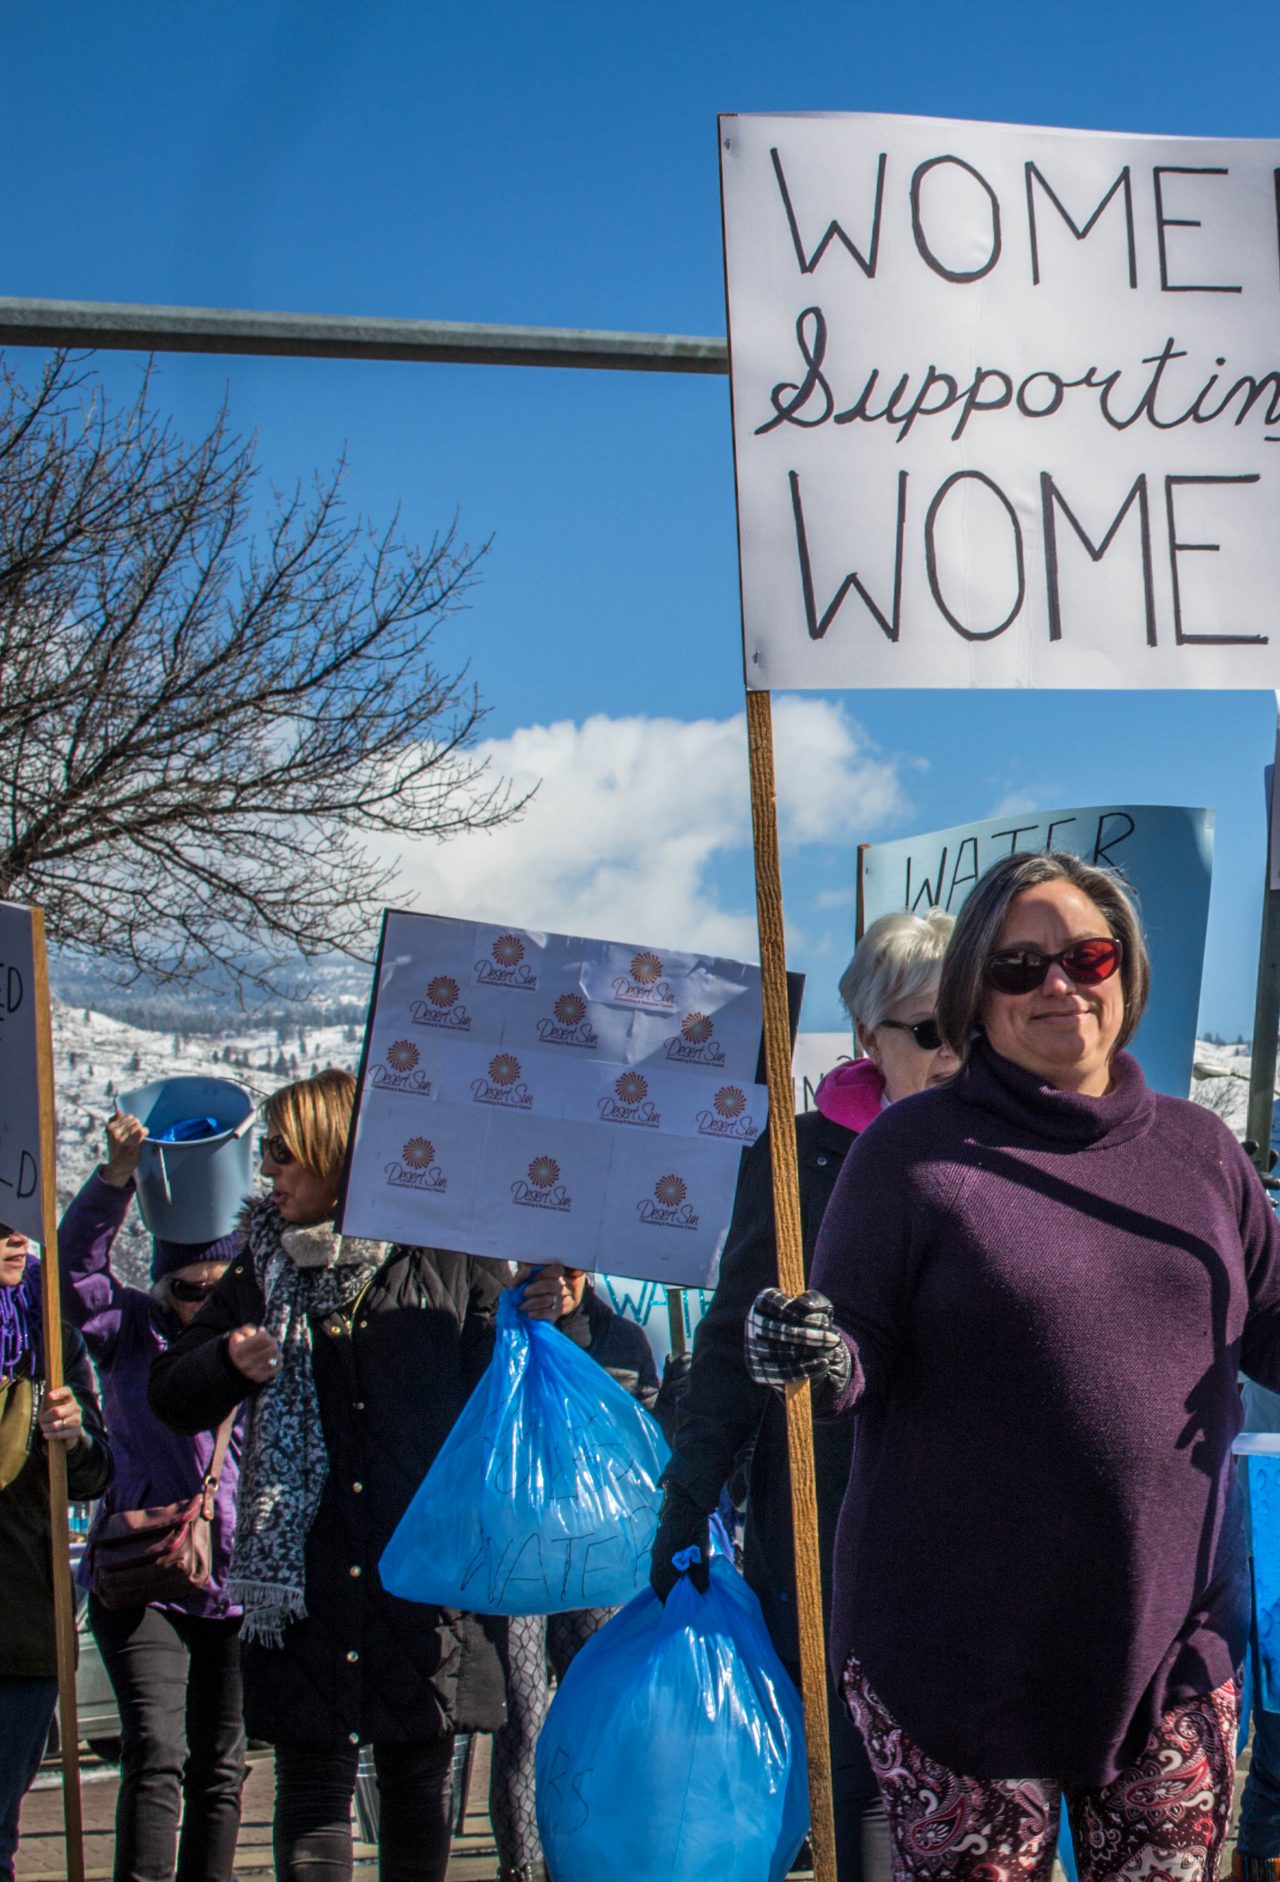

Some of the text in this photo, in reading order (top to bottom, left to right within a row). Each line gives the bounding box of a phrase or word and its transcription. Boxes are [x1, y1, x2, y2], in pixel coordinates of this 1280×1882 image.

[474, 959, 516, 983] Desert
[515, 964, 537, 986] Sun
[611, 976, 654, 1000] Desert
[653, 982, 675, 1004] Sun
[409, 1000, 451, 1024] Desert
[449, 1005, 472, 1027] Sun
[536, 1018, 578, 1041] Desert
[576, 1023, 598, 1045] Sun
[663, 1036, 705, 1060] Desert
[704, 1041, 726, 1063] Sun
[368, 1063, 411, 1088] Desert
[409, 1070, 432, 1092] Sun
[470, 1078, 512, 1102] Desert
[511, 1083, 534, 1105] Sun
[597, 1096, 640, 1120] Desert
[638, 1101, 661, 1124] Sun
[696, 1110, 737, 1134] Desert
[736, 1115, 758, 1138] Sun
[384, 1161, 426, 1185] Desert
[425, 1166, 448, 1188] Sun
[510, 1180, 551, 1204] Desert
[550, 1185, 572, 1208] Sun
[636, 1199, 678, 1222] Desert
[677, 1204, 699, 1226] Sun
